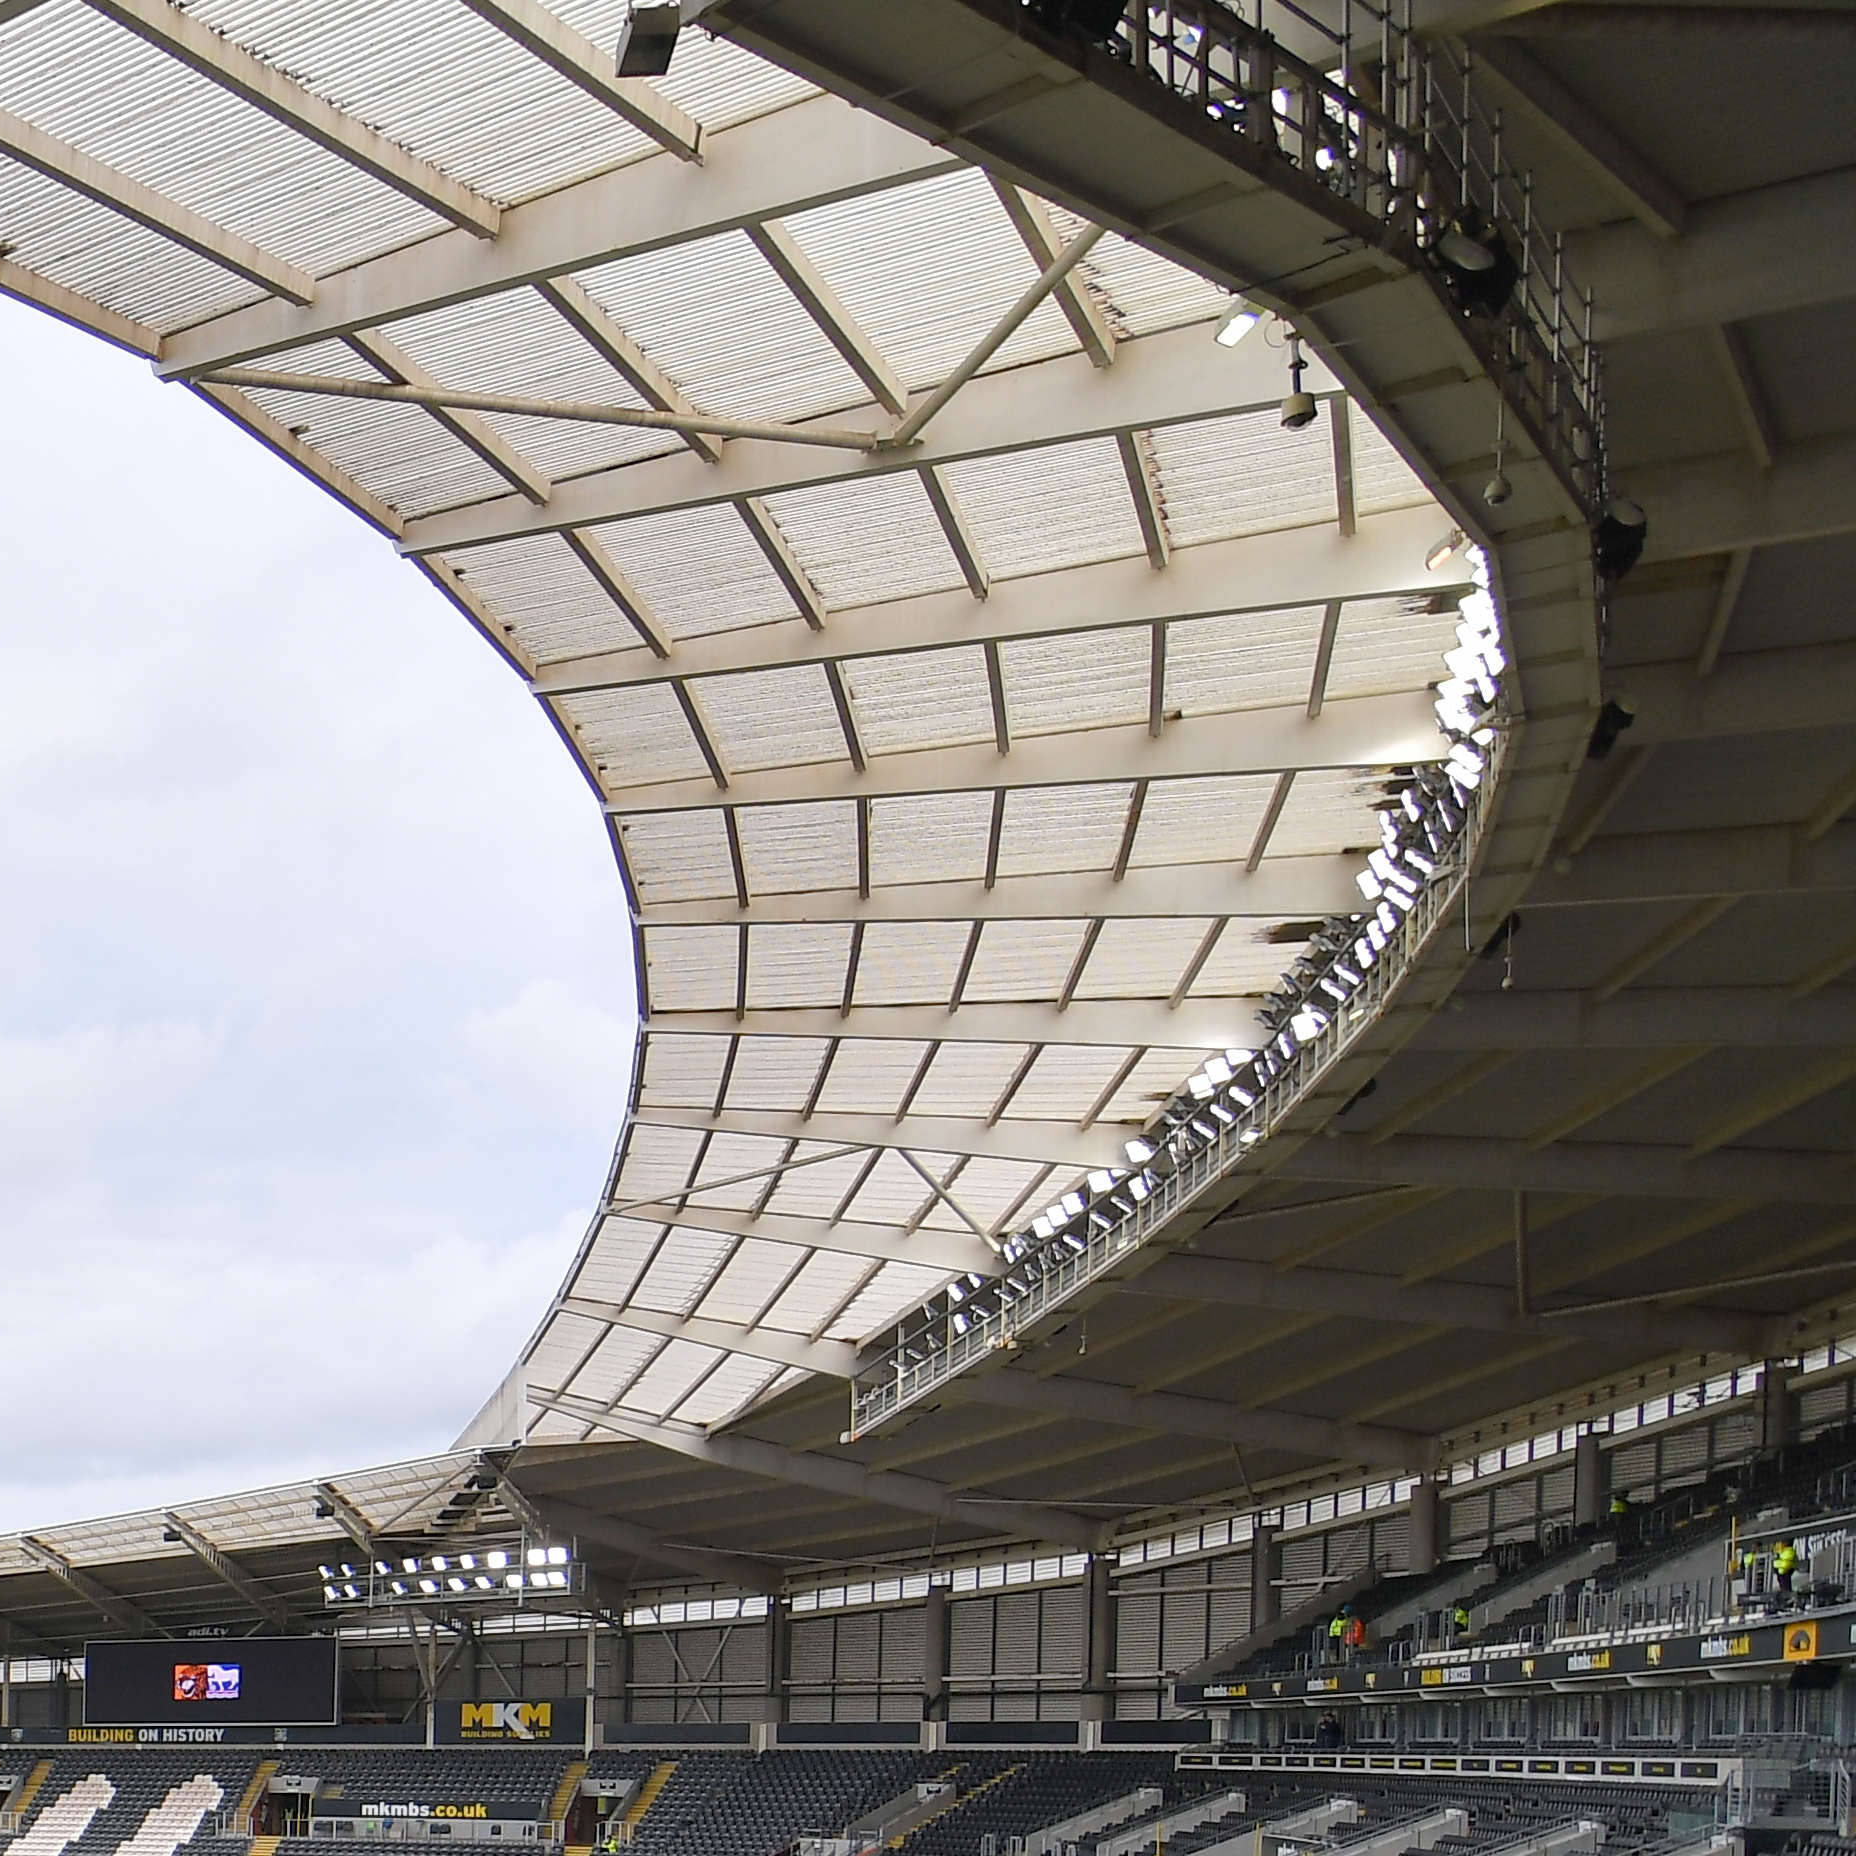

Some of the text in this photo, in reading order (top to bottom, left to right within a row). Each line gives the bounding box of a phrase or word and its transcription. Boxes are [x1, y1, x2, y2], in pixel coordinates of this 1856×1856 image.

[461, 1703, 552, 1740] MKM
[68, 1728, 224, 1742] BUILDING ON HISTORY
[361, 1802, 488, 1818] mkmbs.co.uk
